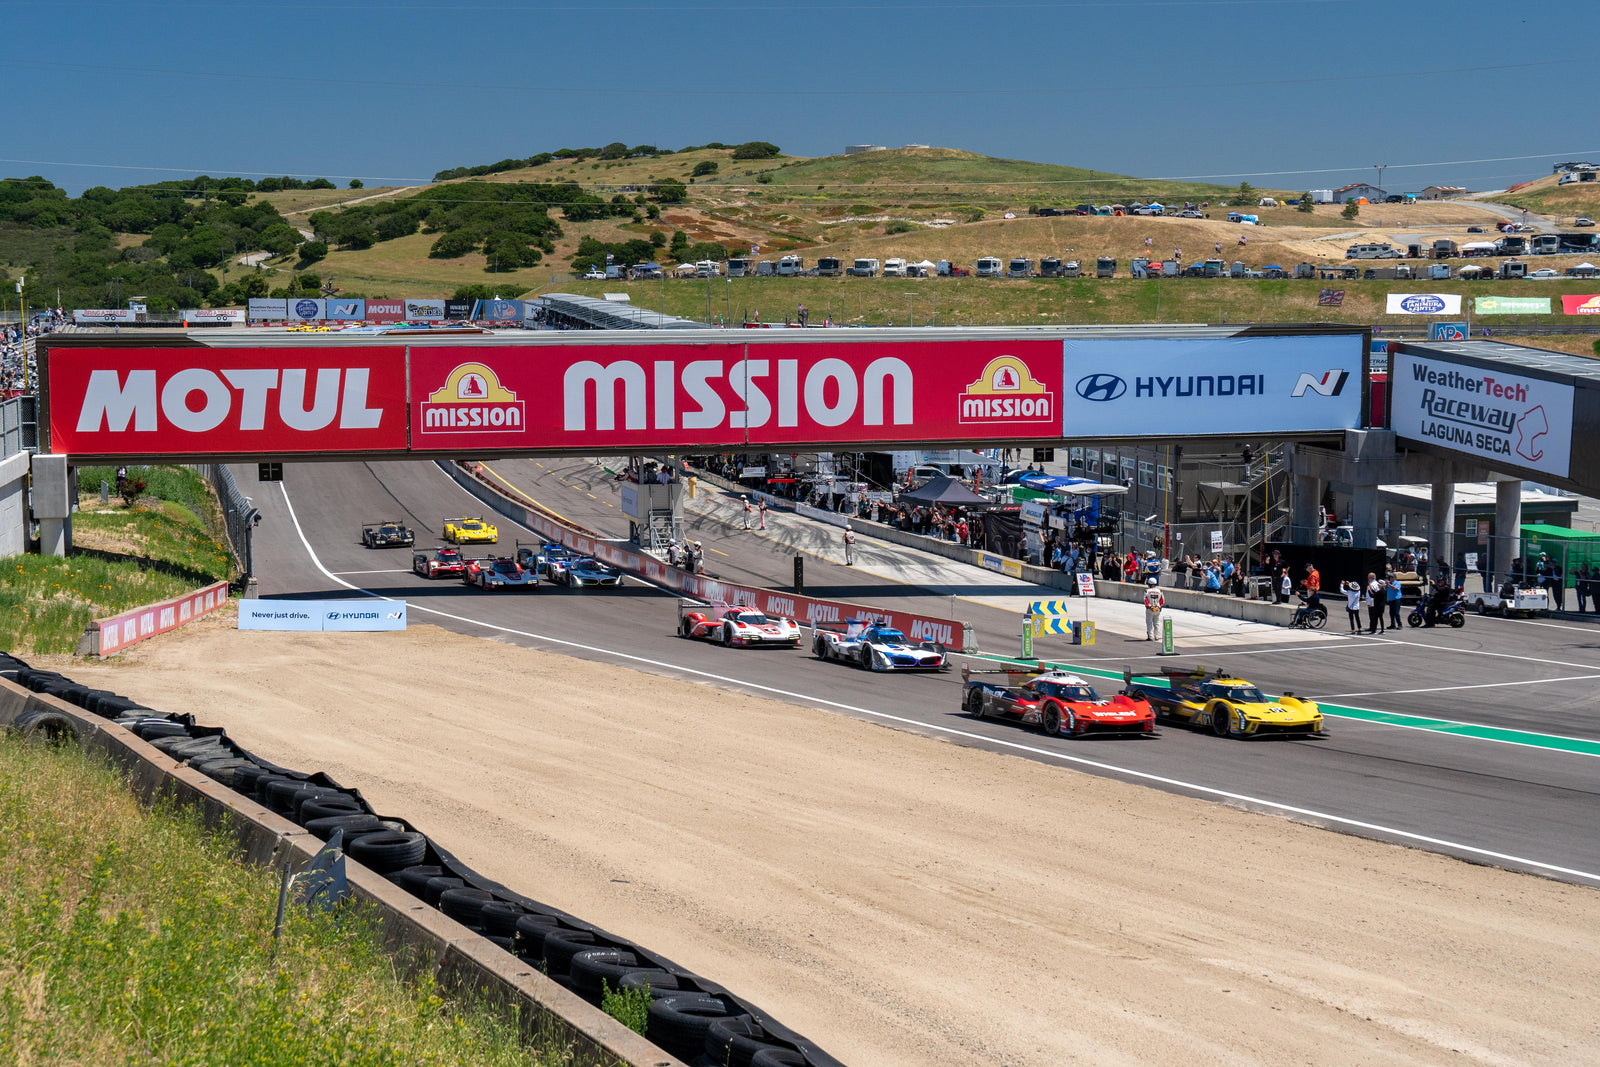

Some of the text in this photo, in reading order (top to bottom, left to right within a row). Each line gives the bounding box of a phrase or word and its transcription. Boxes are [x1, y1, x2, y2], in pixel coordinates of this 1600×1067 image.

[368, 305, 402, 314] MOTUL
[564, 356, 914, 431] MISSION
[1135, 374, 1264, 398] HYUNDAI
[76, 367, 384, 433] MOTUL
[962, 398, 1049, 418] MISSION
[1420, 388, 1517, 435] Raceway
[425, 407, 521, 427] MISSION
[1420, 420, 1512, 456] LAGUNA SECA
[251, 611, 310, 620] Never just drive.
[767, 595, 795, 617] MOTUL
[806, 602, 840, 622] MOTUL
[910, 619, 953, 645] MOTUL
